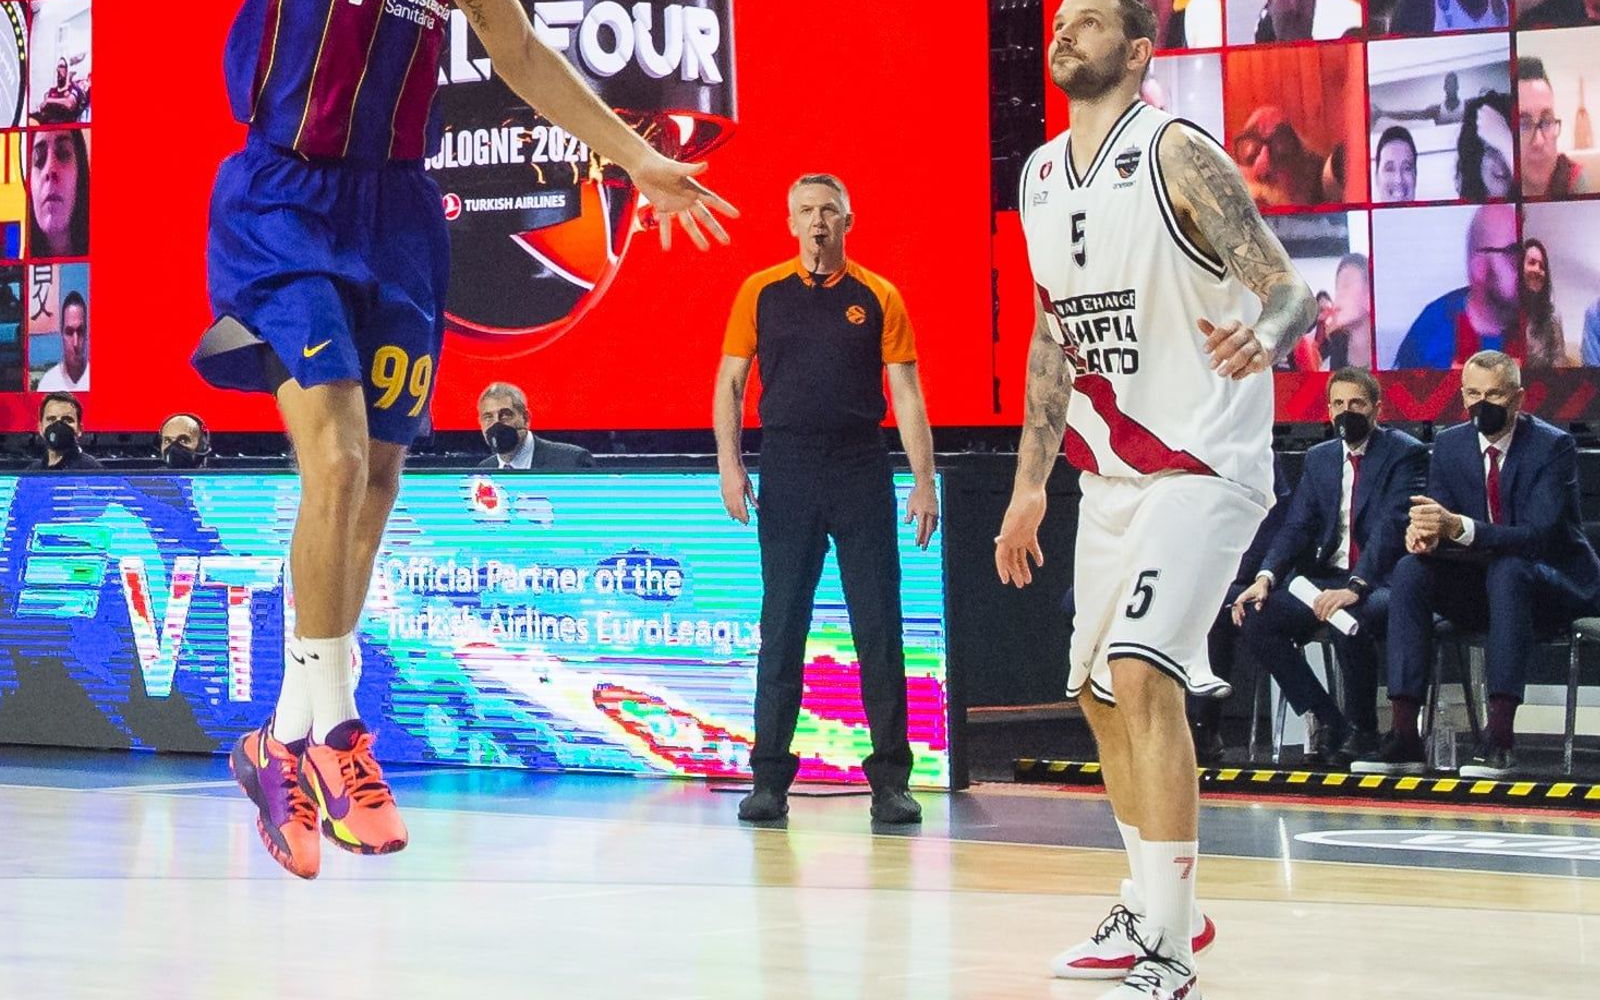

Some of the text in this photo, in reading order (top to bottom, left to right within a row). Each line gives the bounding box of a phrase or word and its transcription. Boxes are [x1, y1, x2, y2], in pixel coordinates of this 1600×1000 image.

[534, 0, 723, 85] FOUR
[425, 125, 588, 171] OLOGNE 2021
[465, 195, 565, 212] TURKISH AIRLINES
[1069, 210, 1087, 268] 5
[371, 344, 434, 418] 99
[386, 557, 683, 597] Official Partner of the
[1125, 569, 1160, 620] 5
[119, 555, 292, 702] VT
[488, 605, 589, 645] Airlines
